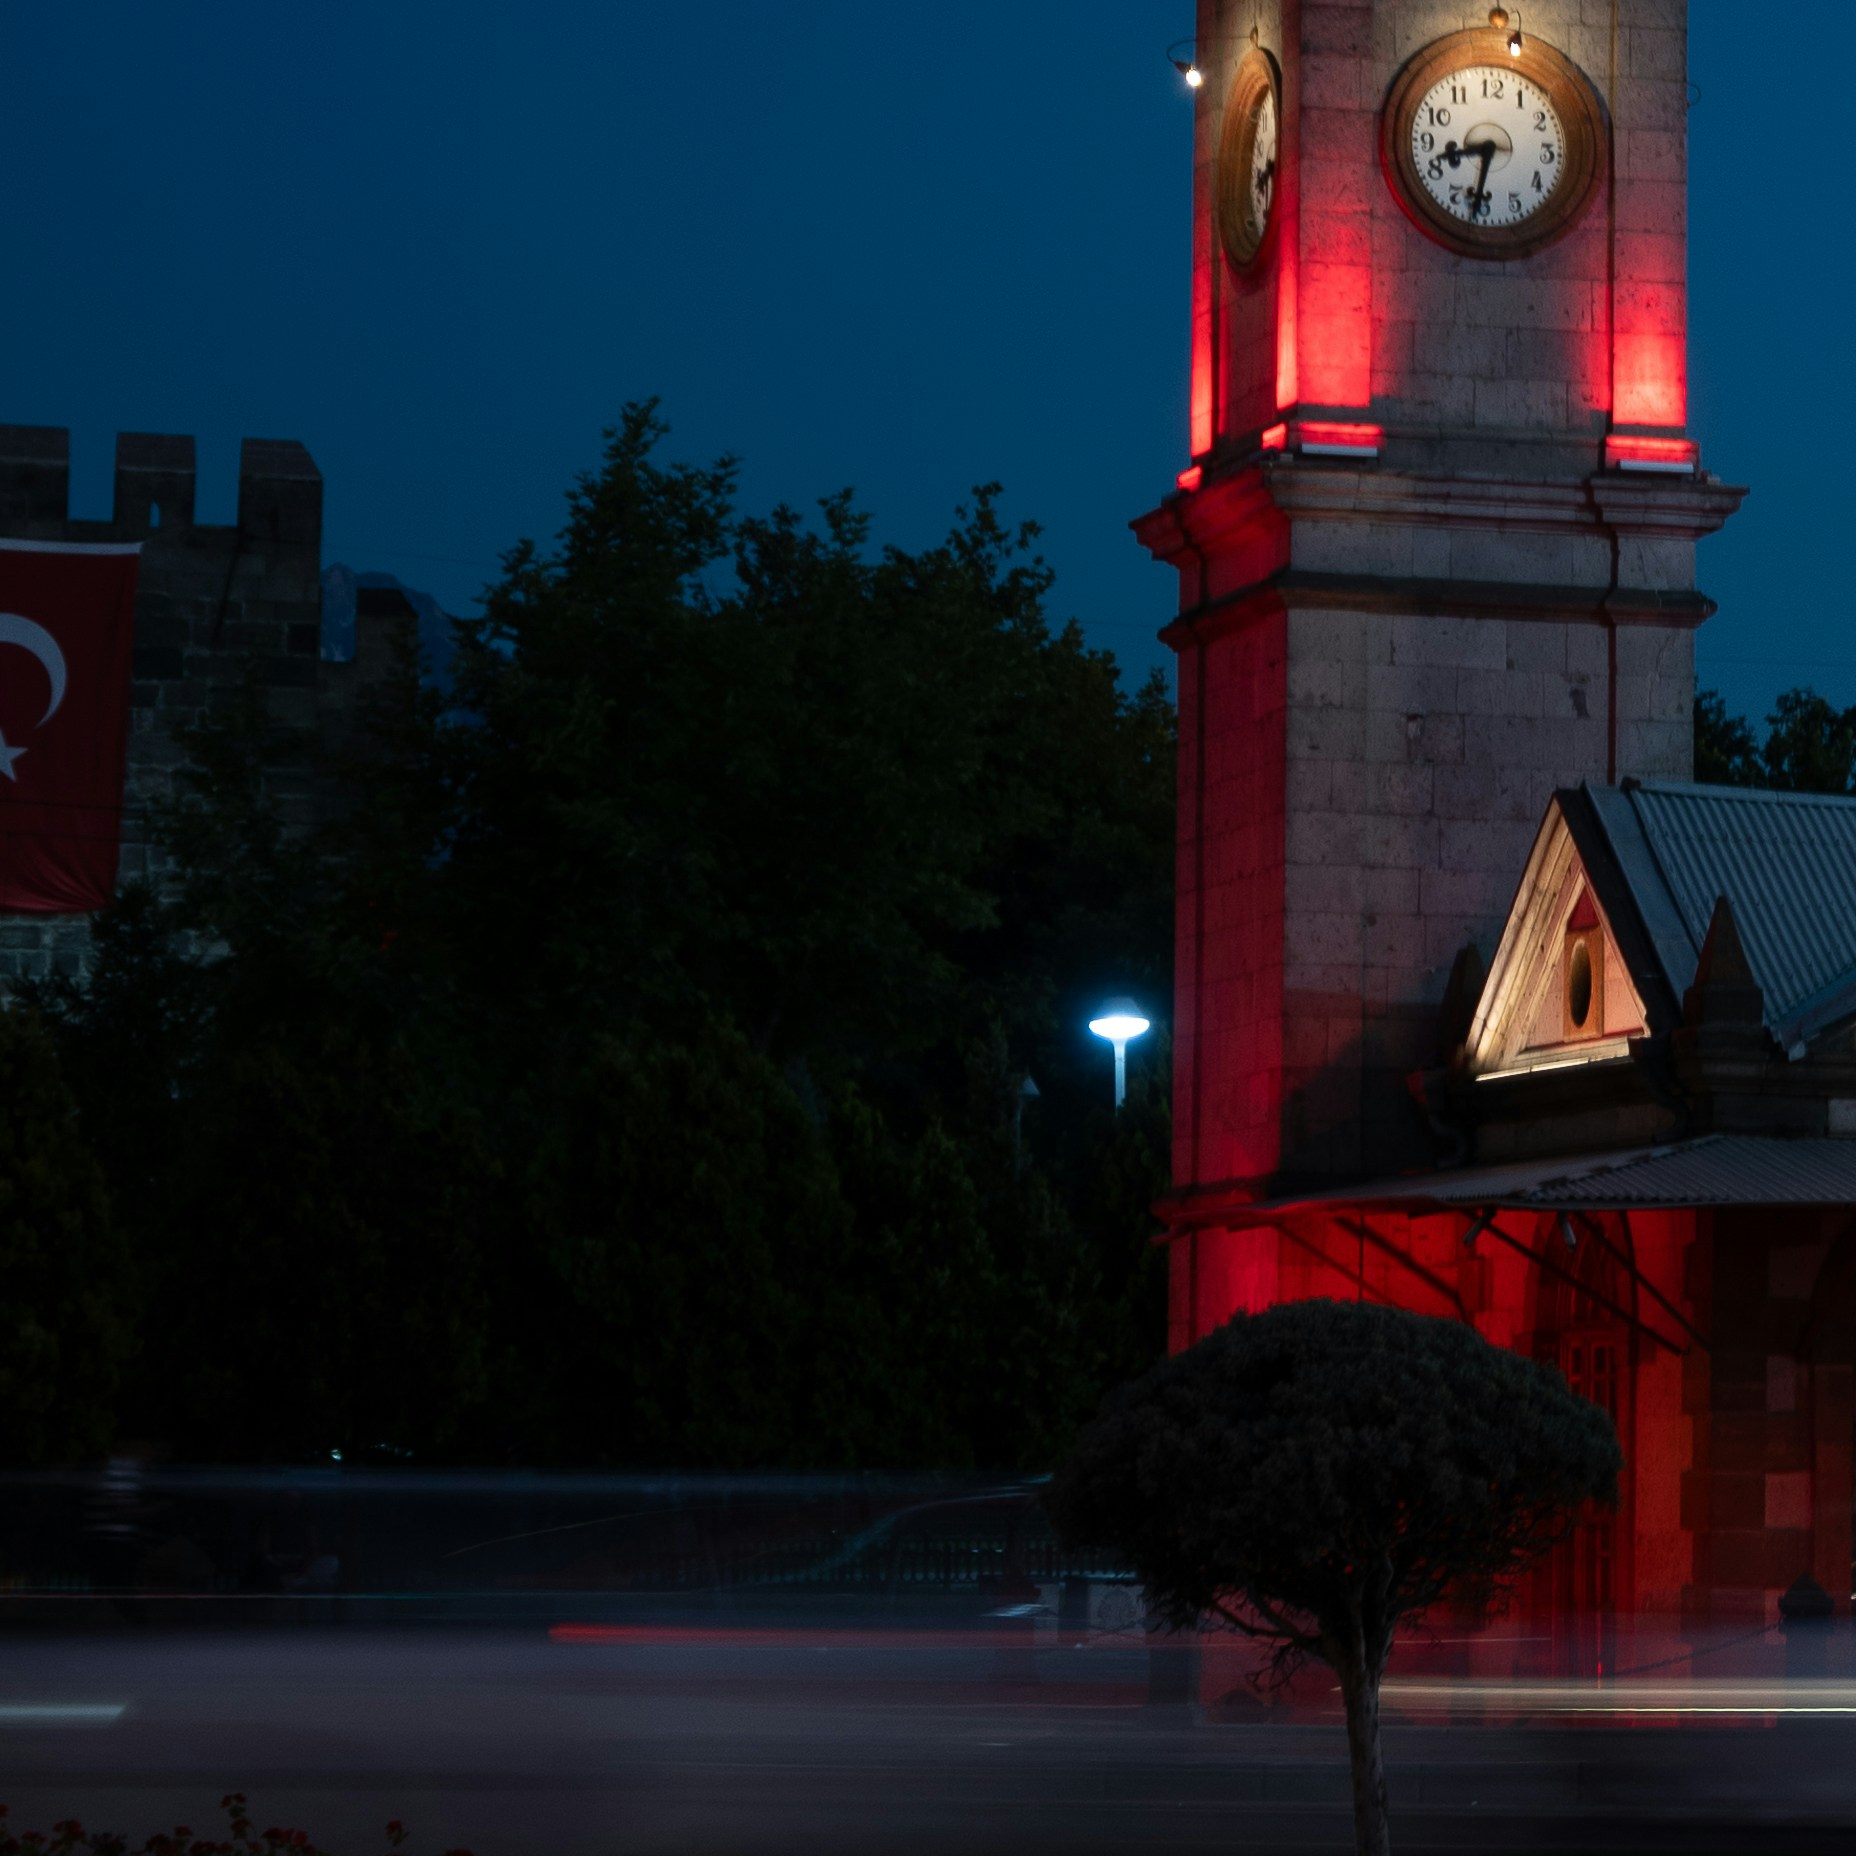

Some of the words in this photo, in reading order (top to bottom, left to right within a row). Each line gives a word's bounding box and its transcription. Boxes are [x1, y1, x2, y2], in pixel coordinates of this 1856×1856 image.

[1450, 85, 1468, 105] 11
[1480, 78, 1504, 99] 12
[1516, 89, 1525, 109] 1
[1428, 107, 1451, 126] 10
[1533, 111, 1547, 132] 2
[1420, 132, 1434, 152] 9
[1540, 142, 1555, 164] 3
[1427, 157, 1444, 181] 8
[1530, 170, 1543, 192] 4
[1449, 184, 1463, 205] 7
[1508, 192, 1522, 213] 5
